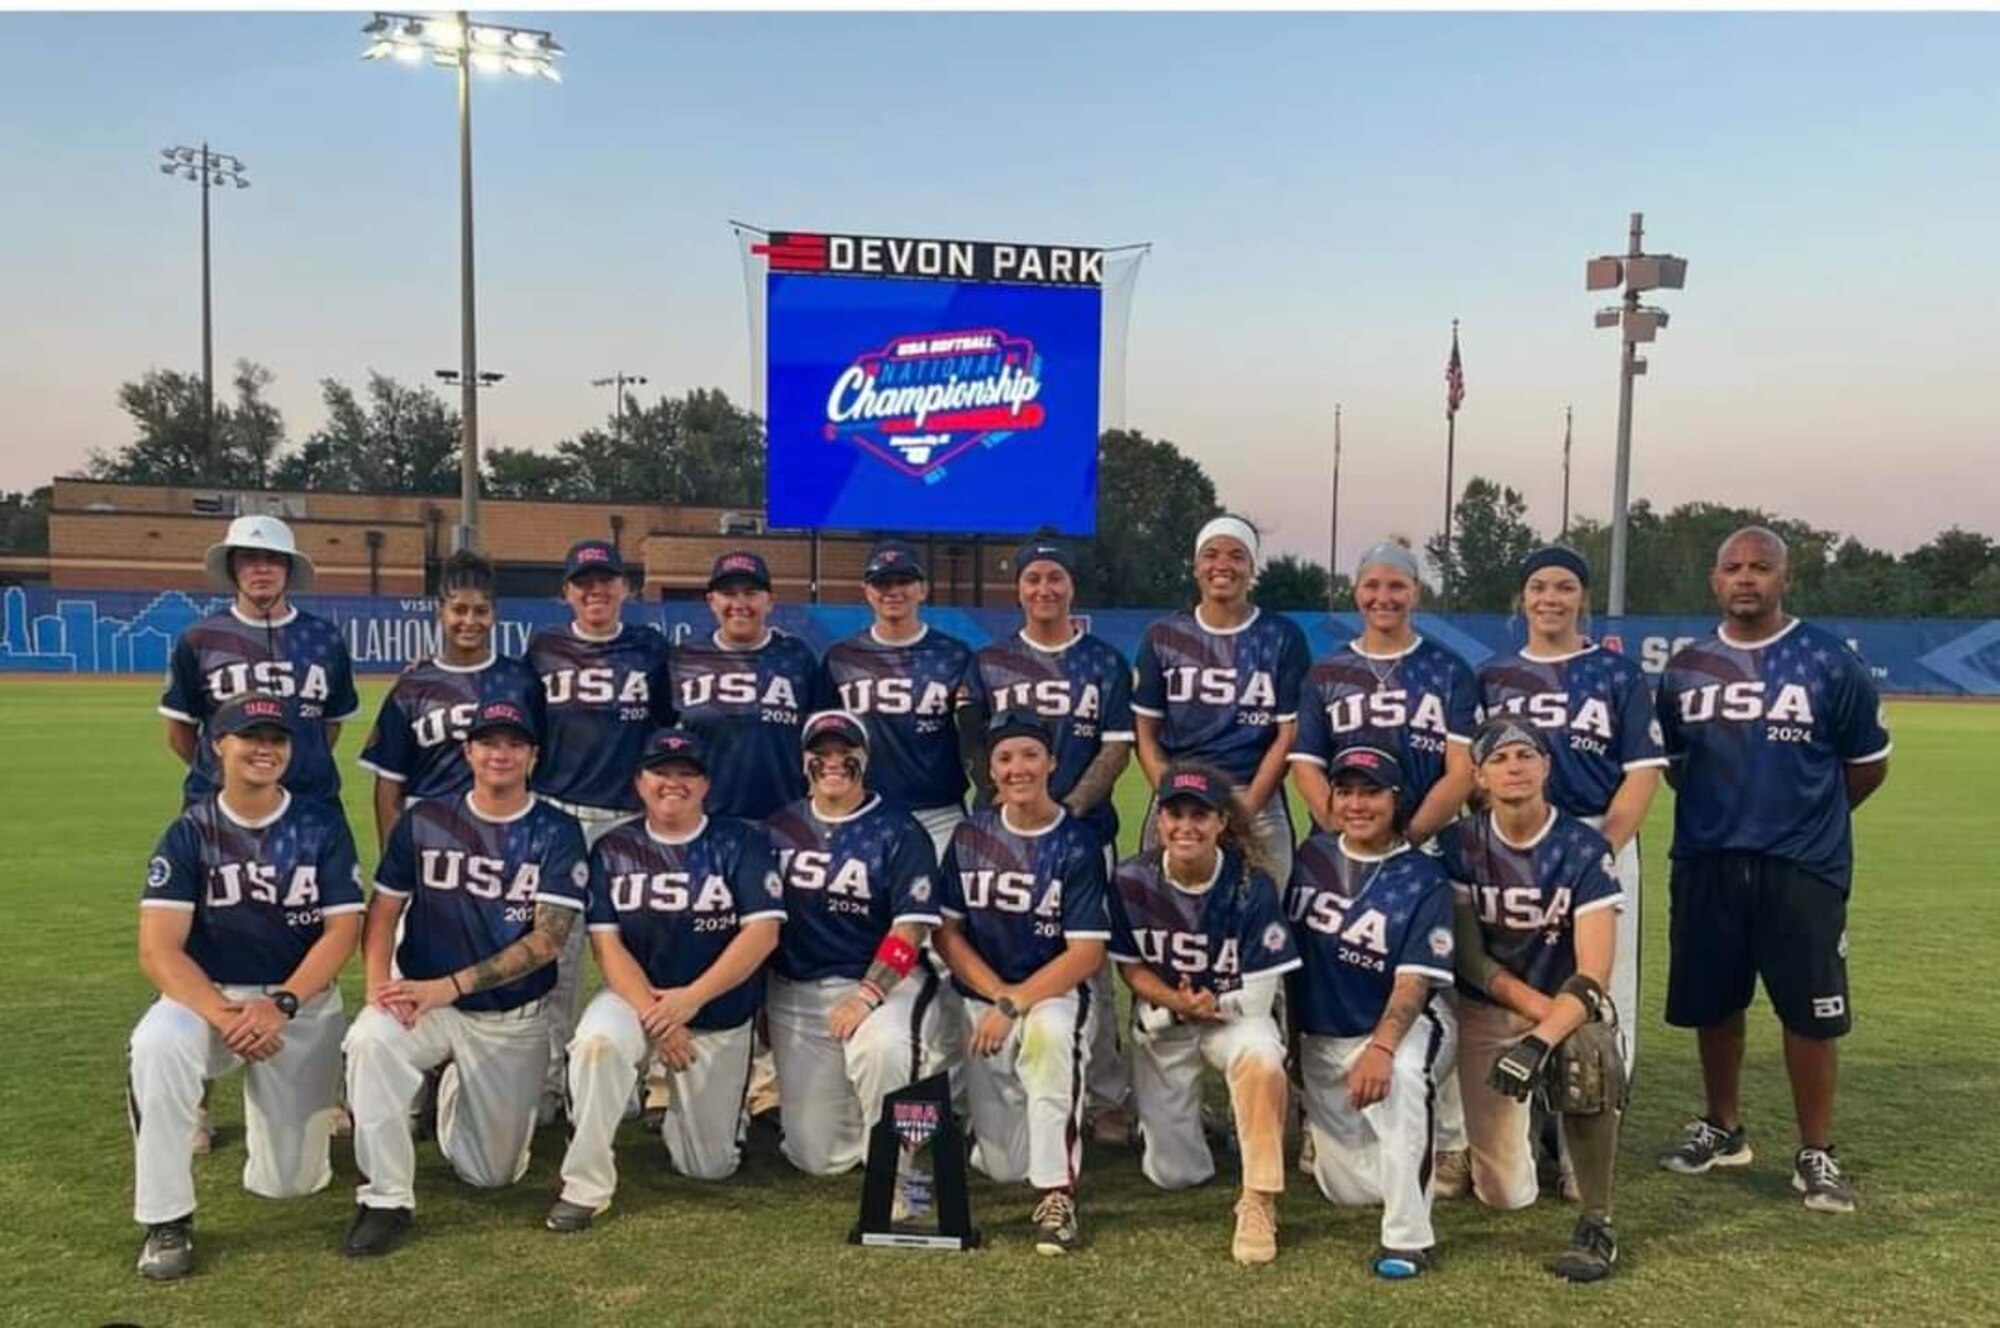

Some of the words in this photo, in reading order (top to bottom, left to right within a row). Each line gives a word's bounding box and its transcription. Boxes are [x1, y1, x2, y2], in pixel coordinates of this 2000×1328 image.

[829, 236, 974, 277] DEVON
[993, 246, 1104, 283] PARK
[826, 362, 1041, 428] Championship
[207, 661, 329, 701] USA
[541, 668, 650, 703] USA
[680, 672, 799, 710] USA
[838, 678, 949, 715] USA
[1162, 667, 1276, 706] USA
[1237, 711, 1272, 726] 202
[1325, 690, 1448, 734] USA
[1680, 681, 1814, 725] USA
[412, 703, 480, 748] US
[1766, 726, 1813, 744] 2024
[207, 861, 320, 907] USA
[421, 849, 541, 901] USA
[610, 872, 734, 911] USA
[959, 869, 1062, 917] USA
[285, 908, 323, 926] 202
[693, 913, 737, 932] 2024
[1288, 886, 1389, 955] USA
[1131, 928, 1239, 974] USA
[1337, 947, 1386, 972] 2024
